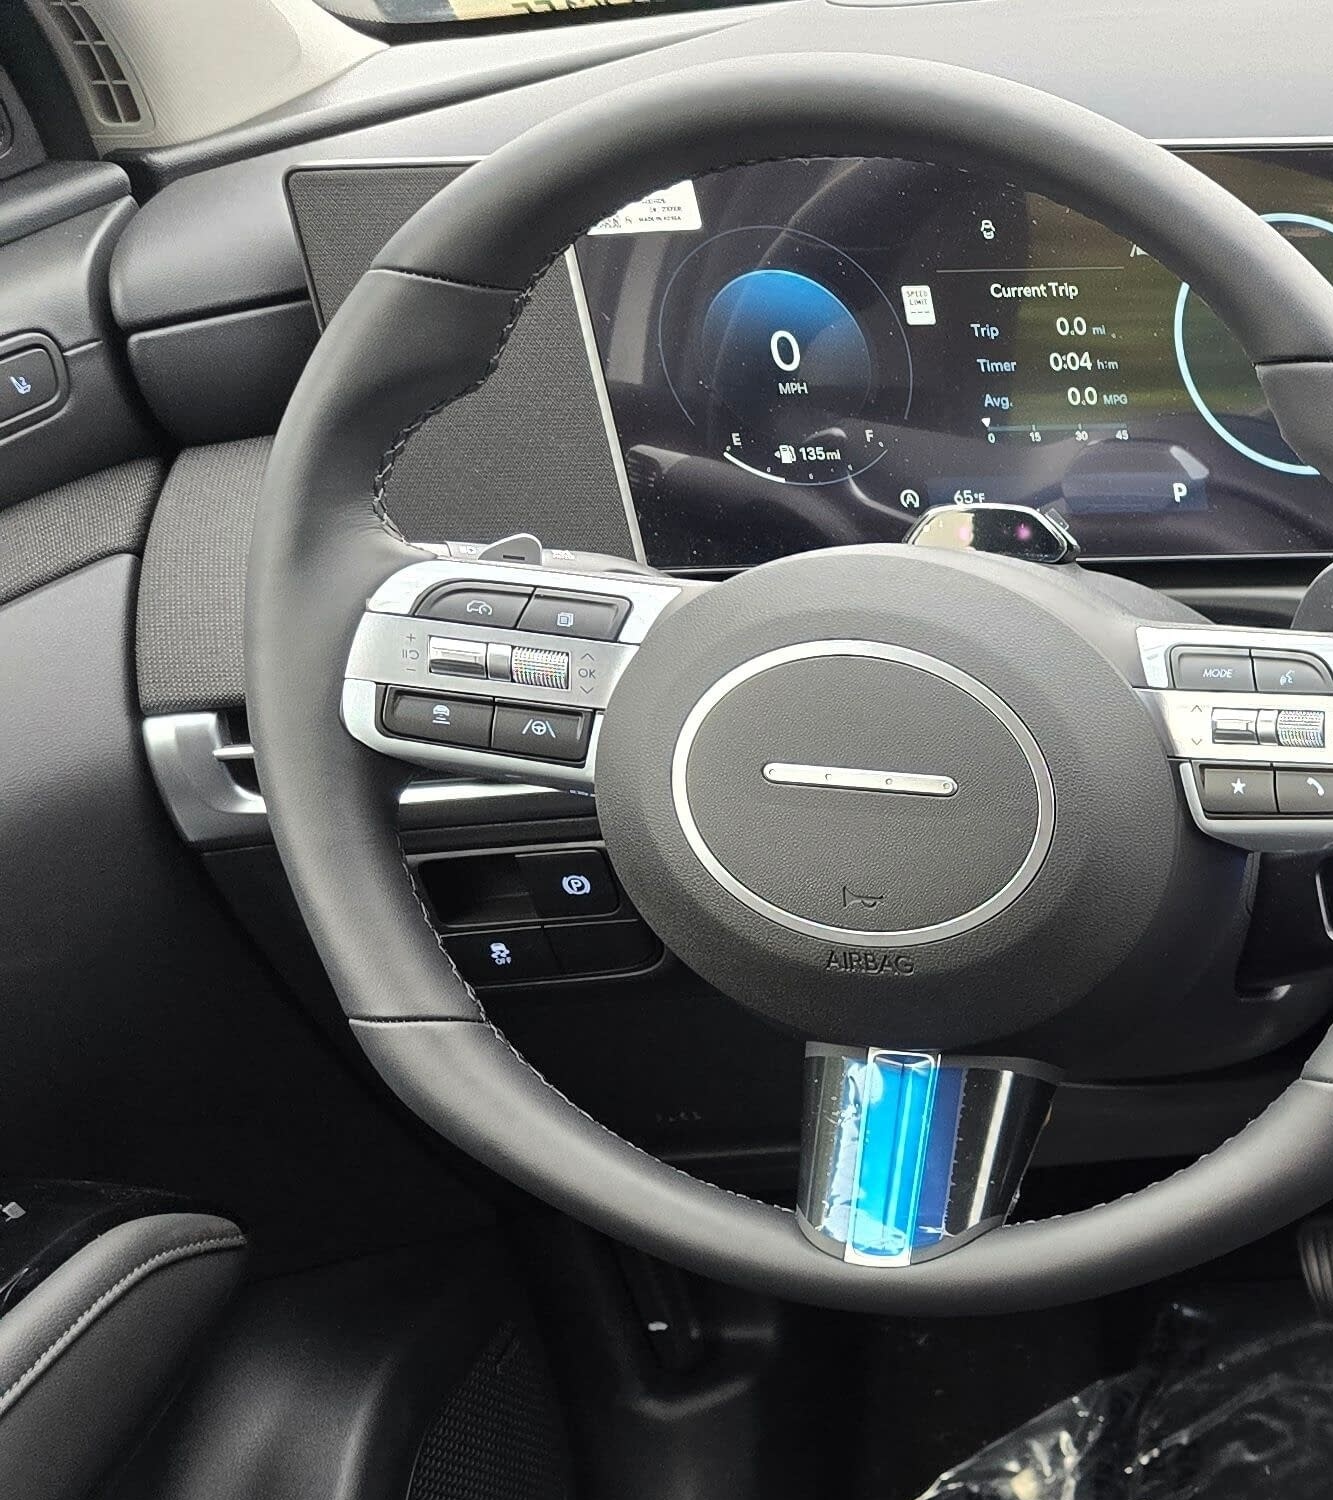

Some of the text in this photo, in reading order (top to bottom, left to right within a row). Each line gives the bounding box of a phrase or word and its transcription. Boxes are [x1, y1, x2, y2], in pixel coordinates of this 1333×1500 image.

[990, 282, 1079, 300] Current Trip
[970, 316, 1106, 340] Trip 0.0 mi
[770, 330, 800, 372] 0
[976, 351, 1119, 373] Timer 0:04 h:m
[778, 382, 808, 395] MPH
[984, 386, 1128, 410] Avg. 0.0 MPG
[732, 433, 742, 446] E
[865, 429, 874, 442] F
[1030, 431, 1041, 442] 15
[1075, 430, 1088, 442] 30
[1115, 429, 1129, 440] 45
[1172, 482, 1187, 503] P
[578, 668, 596, 680] OK
[1203, 669, 1233, 679] MODE
[826, 949, 915, 976] AIRBAG
